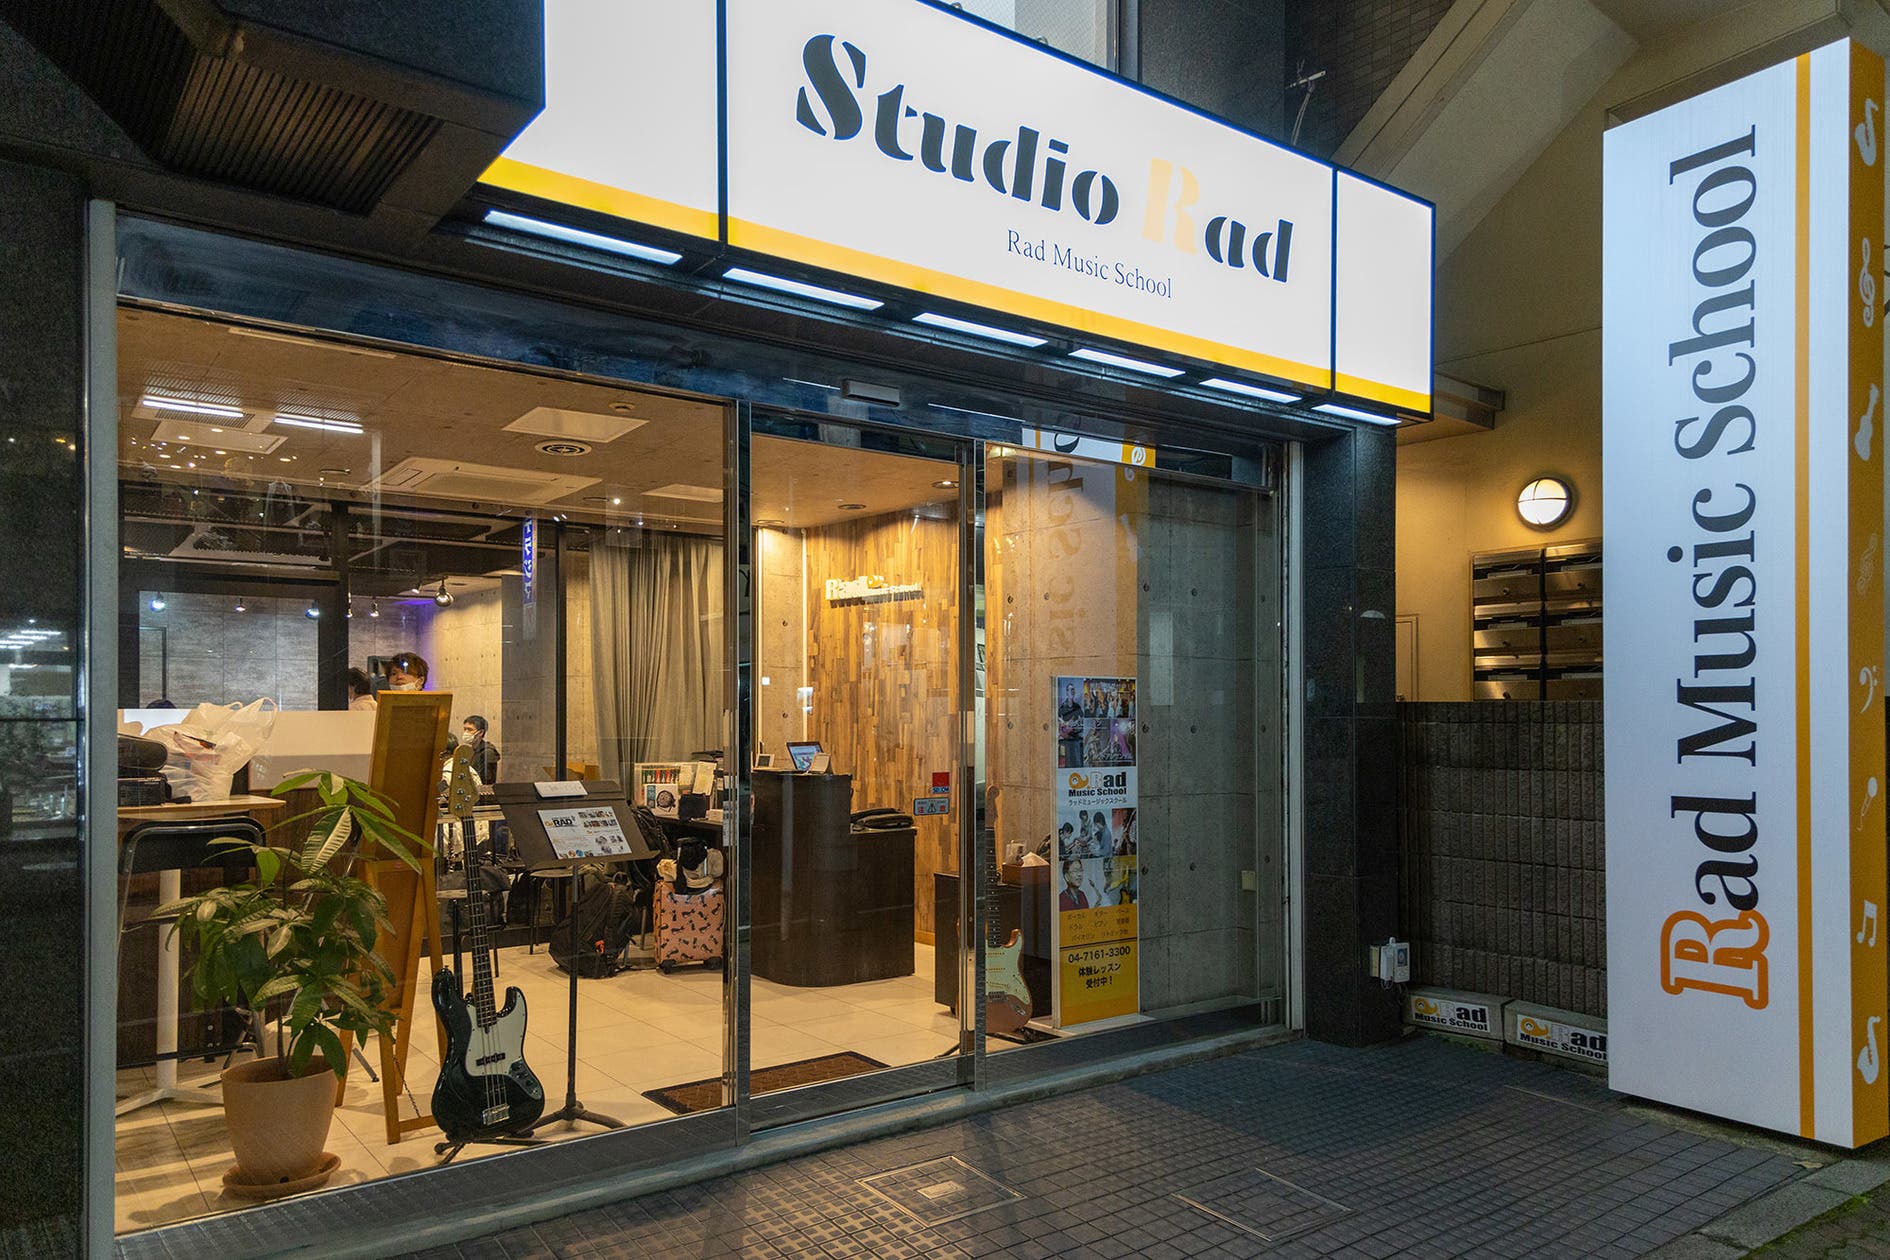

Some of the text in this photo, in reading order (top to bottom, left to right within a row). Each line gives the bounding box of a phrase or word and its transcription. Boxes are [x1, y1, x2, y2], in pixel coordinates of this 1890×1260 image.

[796, 33, 1294, 283] Studio Rad
[1007, 229, 1172, 299] Rad Music School
[1660, 124, 1770, 1010] Rad Music School
[1089, 771, 1127, 788] Rad
[1068, 787, 1127, 797] Music School
[1067, 945, 1131, 963] 04-7161-3300
[1078, 962, 1122, 977] 体験レッスン
[1414, 1012, 1489, 1032] Music School
[1438, 1001, 1487, 1024] Rad
[1519, 1032, 1558, 1049] Music
[1550, 1021, 1607, 1052] Rad
